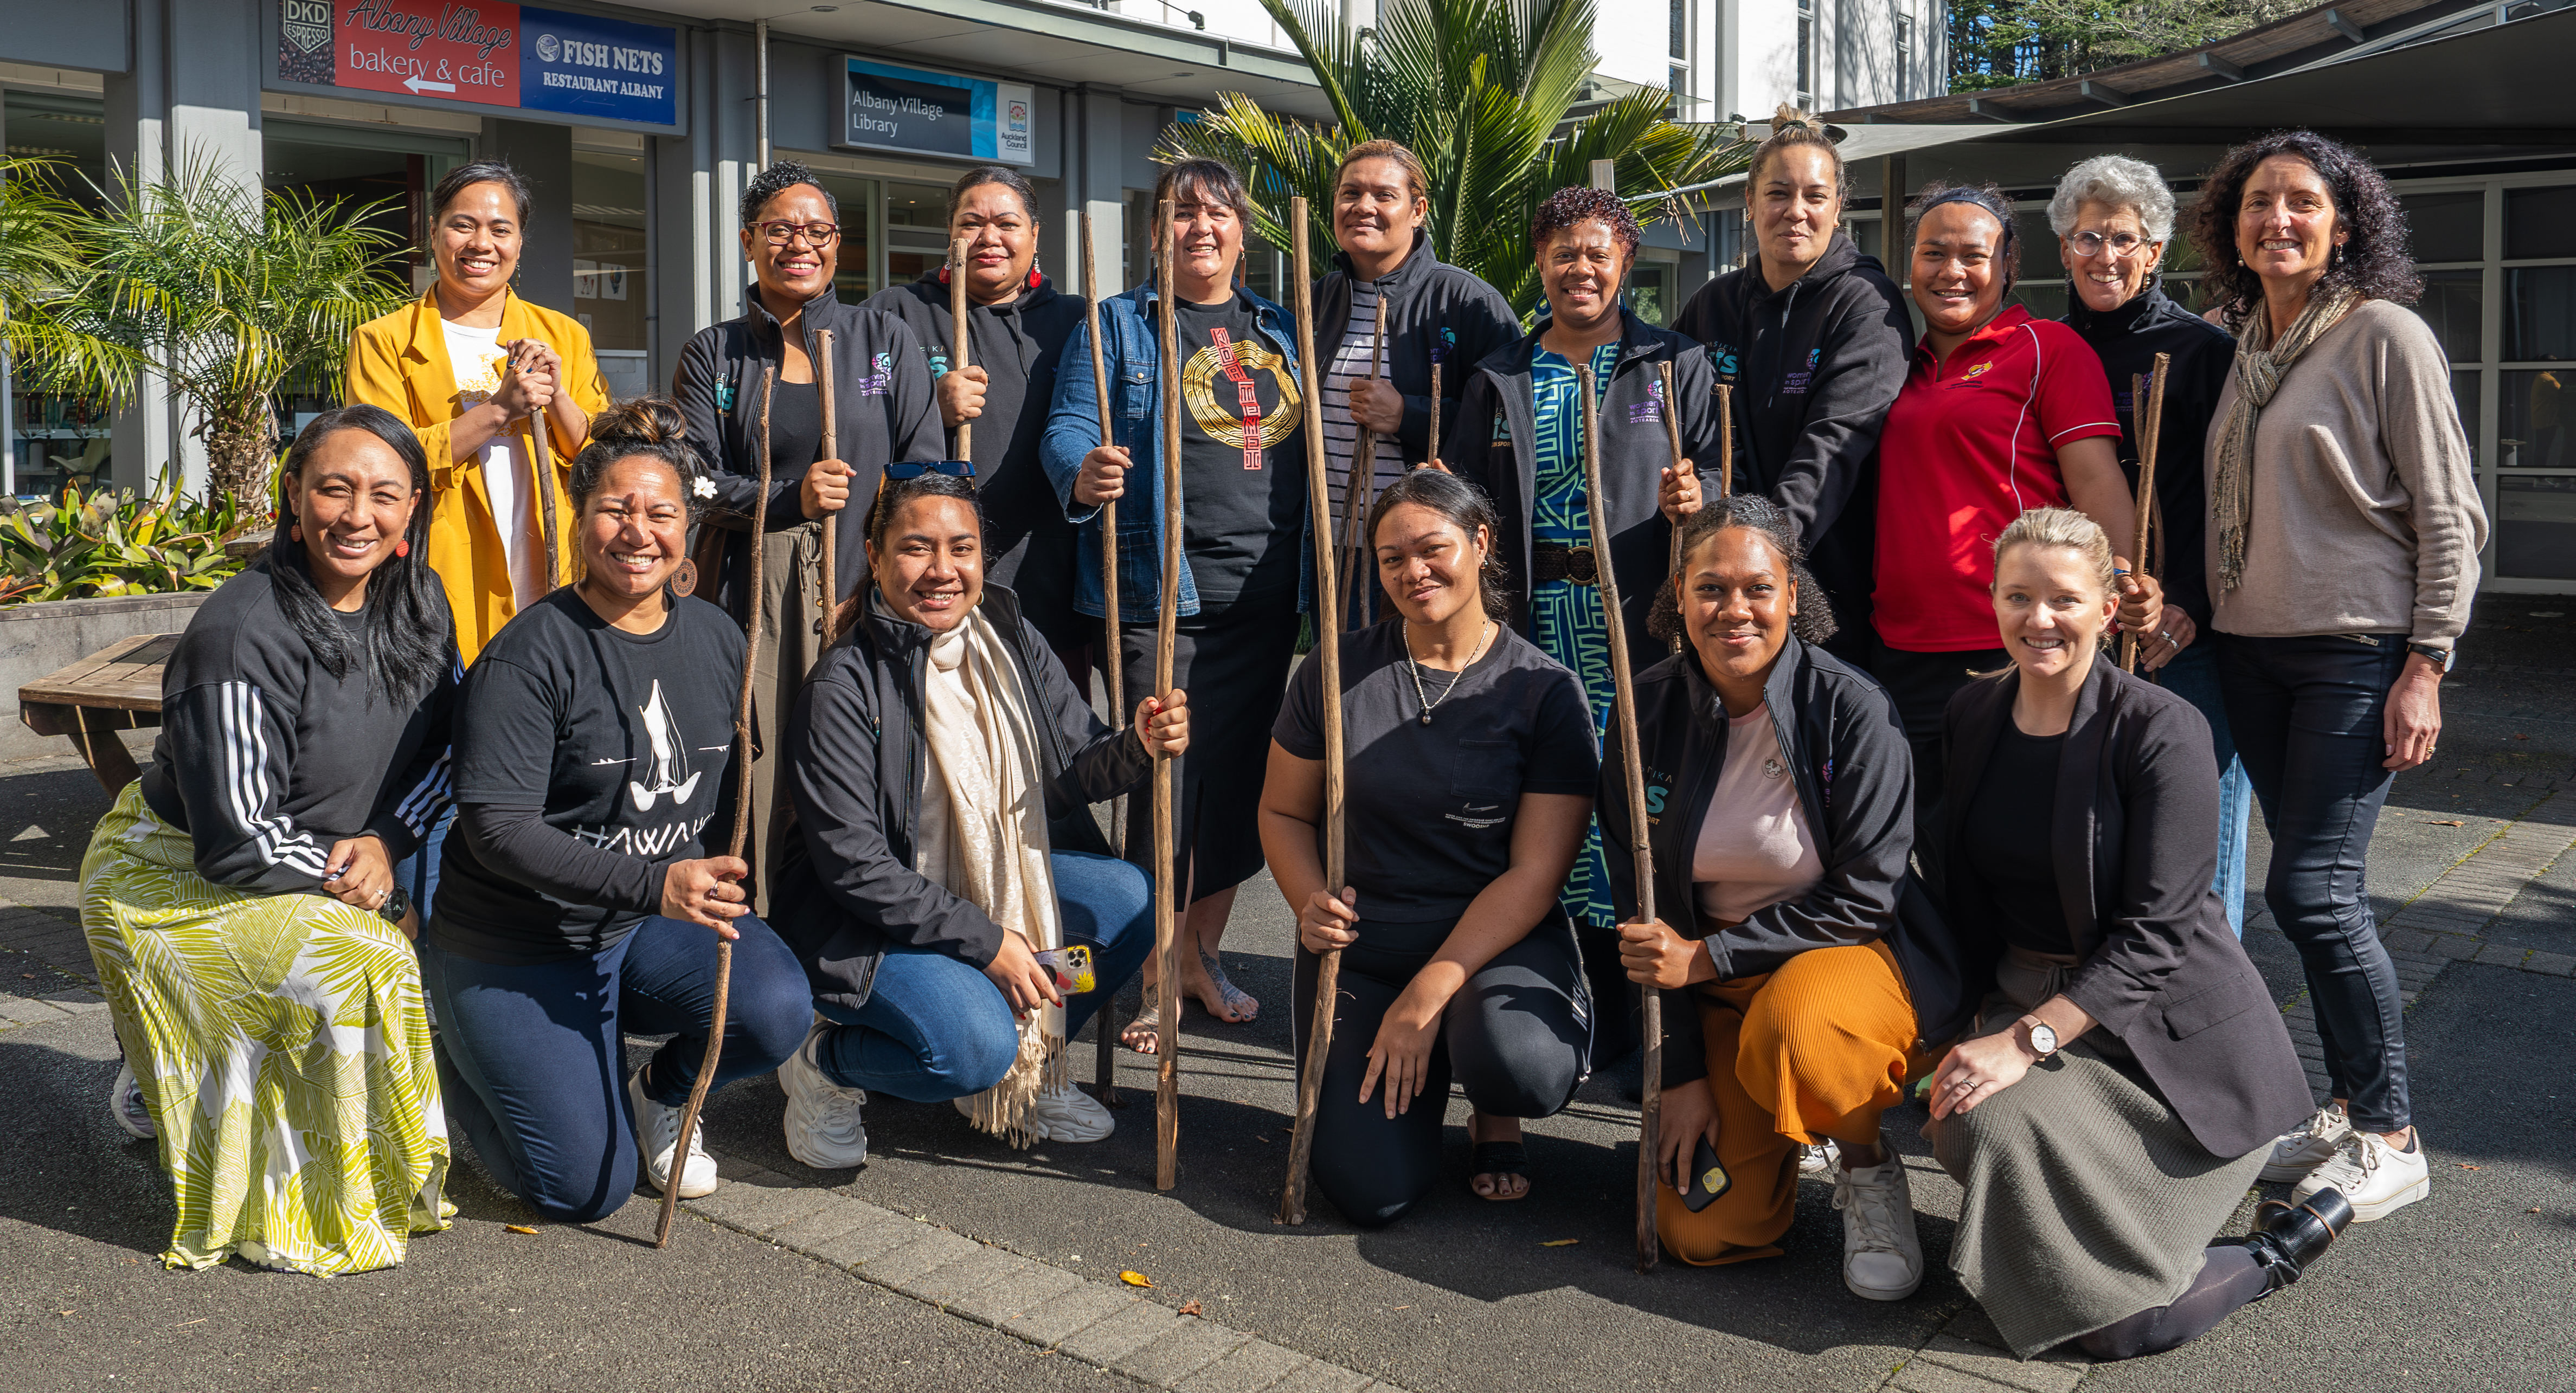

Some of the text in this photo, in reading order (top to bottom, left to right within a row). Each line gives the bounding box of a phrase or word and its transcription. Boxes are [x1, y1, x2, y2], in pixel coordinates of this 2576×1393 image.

[287, 1, 327, 23] DKD
[287, 25, 326, 49] ESPRESSO
[345, 0, 512, 60] Albany Village
[351, 43, 505, 88] bakery & cafe
[563, 40, 663, 75] FISH NETS
[543, 72, 664, 99] RESTAURANT ALBANY
[853, 91, 943, 121] Albany Village
[853, 113, 898, 138] Library
[1001, 132, 1027, 142] Auckland
[1006, 140, 1027, 149] Council
[858, 374, 886, 383] women
[1629, 401, 1659, 410] women
[1636, 406, 1659, 416] sport
